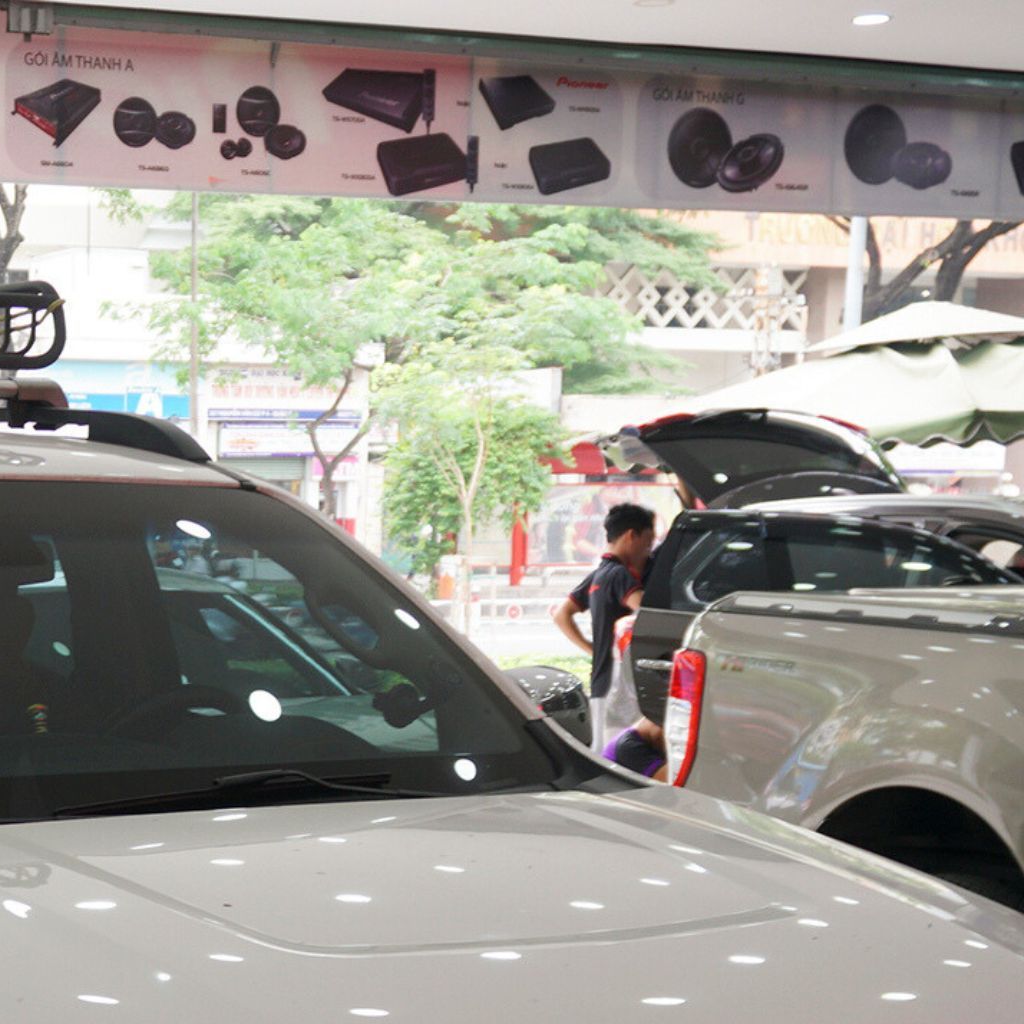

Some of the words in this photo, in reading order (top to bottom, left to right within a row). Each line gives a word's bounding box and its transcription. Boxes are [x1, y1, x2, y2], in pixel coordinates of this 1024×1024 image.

[75, 54, 122, 71] THANH
[125, 58, 135, 72] A
[556, 75, 609, 90] Pioneer
